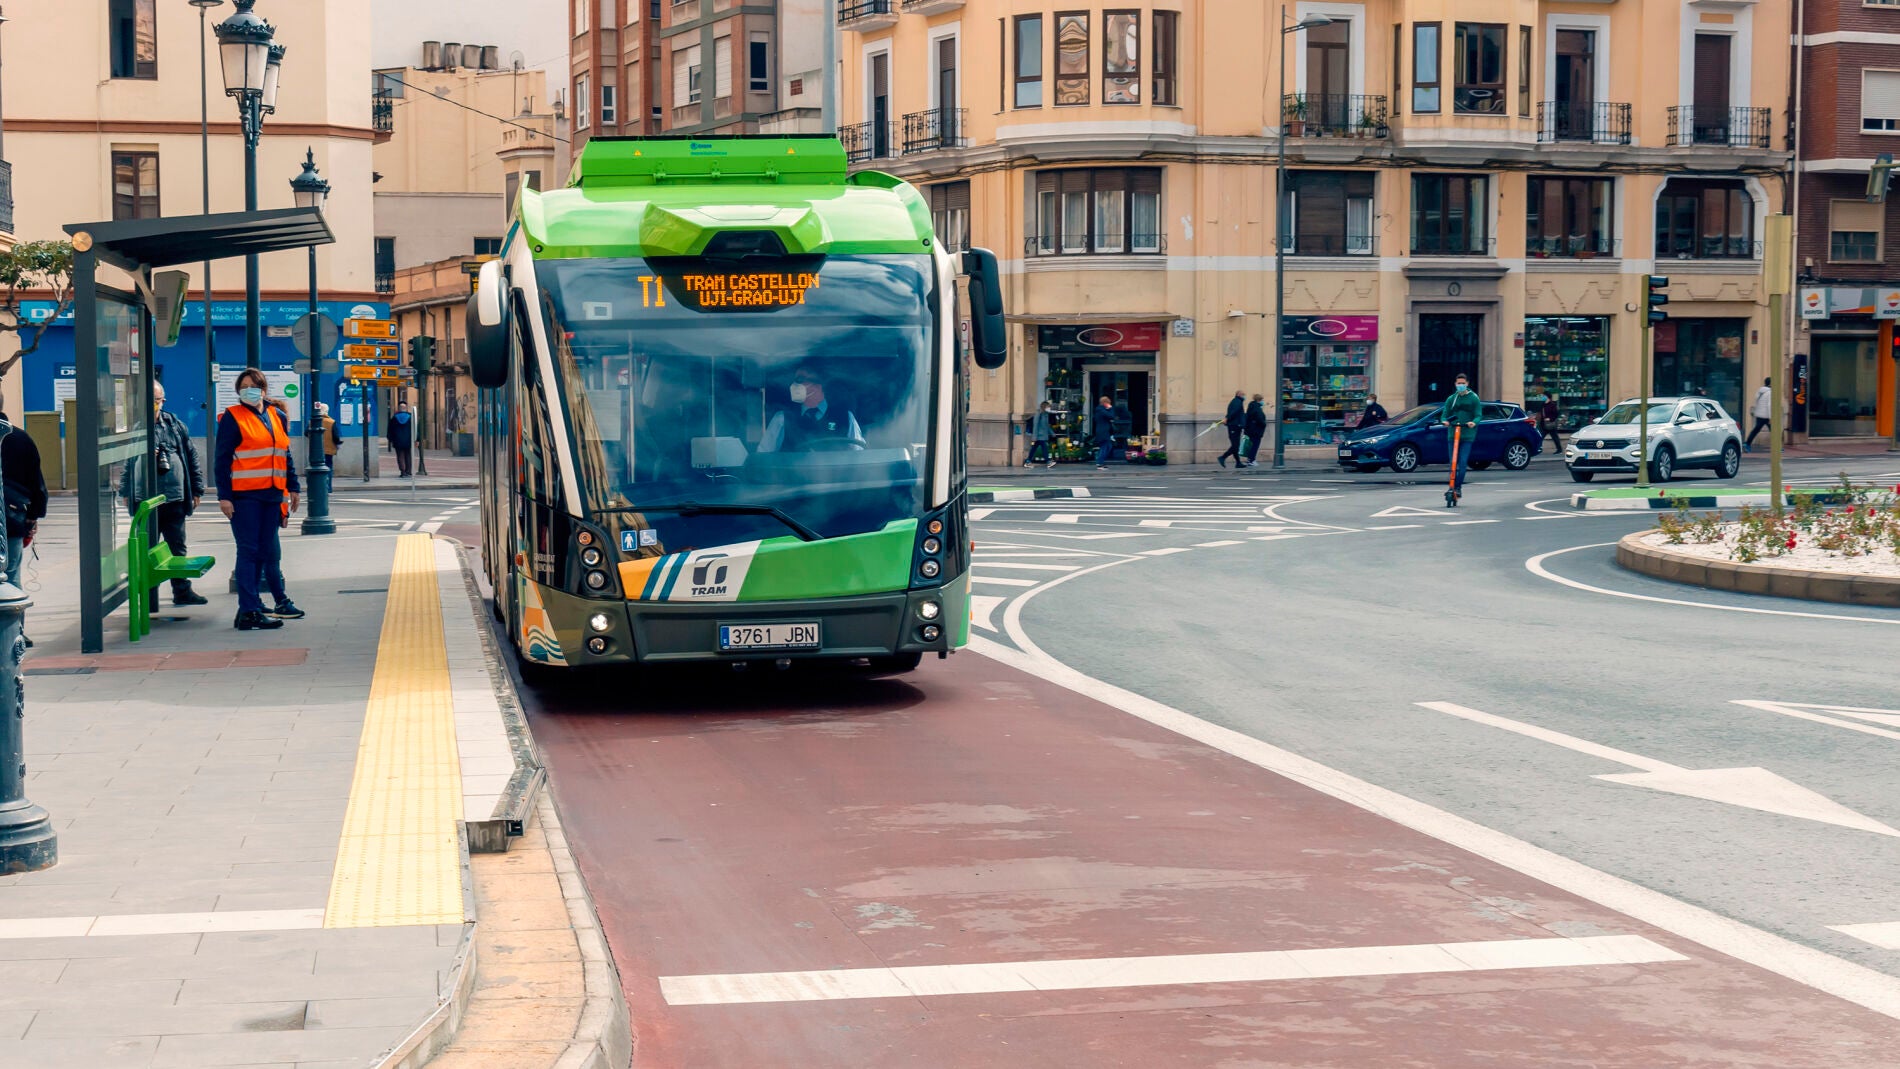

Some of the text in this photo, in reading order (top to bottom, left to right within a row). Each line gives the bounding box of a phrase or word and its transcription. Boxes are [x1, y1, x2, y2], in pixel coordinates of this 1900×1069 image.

[683, 273, 820, 291] TRAM CASTELLON
[637, 275, 665, 308] T1
[700, 289, 805, 306] UJI-GRAO-UJI
[691, 586, 727, 595] TRAM
[732, 626, 815, 645] 3761 JBN
